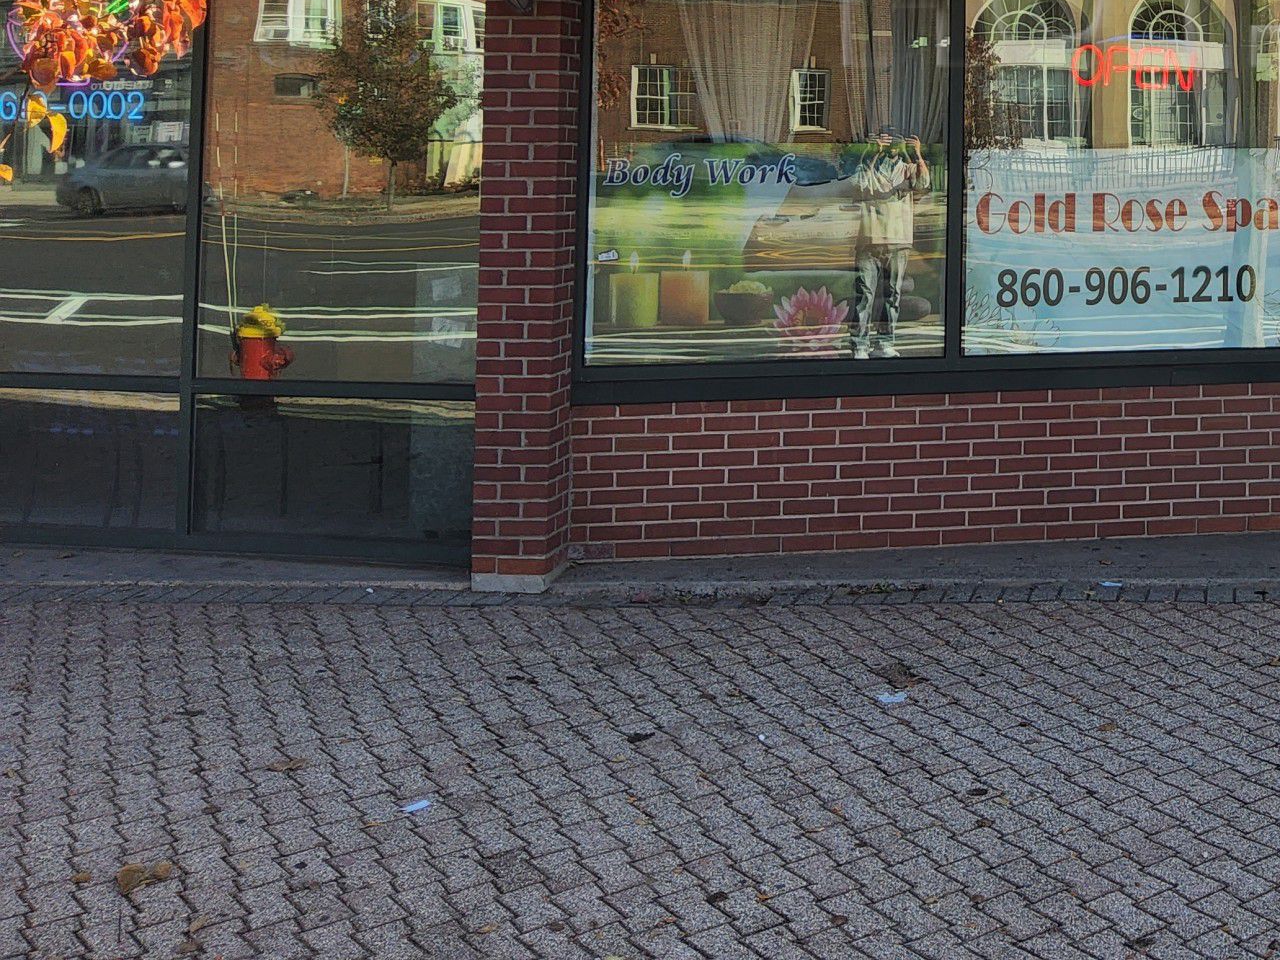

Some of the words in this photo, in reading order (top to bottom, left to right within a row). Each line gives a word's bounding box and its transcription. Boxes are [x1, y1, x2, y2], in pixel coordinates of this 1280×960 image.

[1072, 44, 1197, 91] OPEN
[603, 153, 695, 198] Body
[704, 153, 797, 186] Work
[976, 192, 1076, 234] Gold
[1092, 192, 1188, 232] Rose
[1202, 190, 1280, 232] Spa
[996, 264, 1256, 307] 860-906-1210
